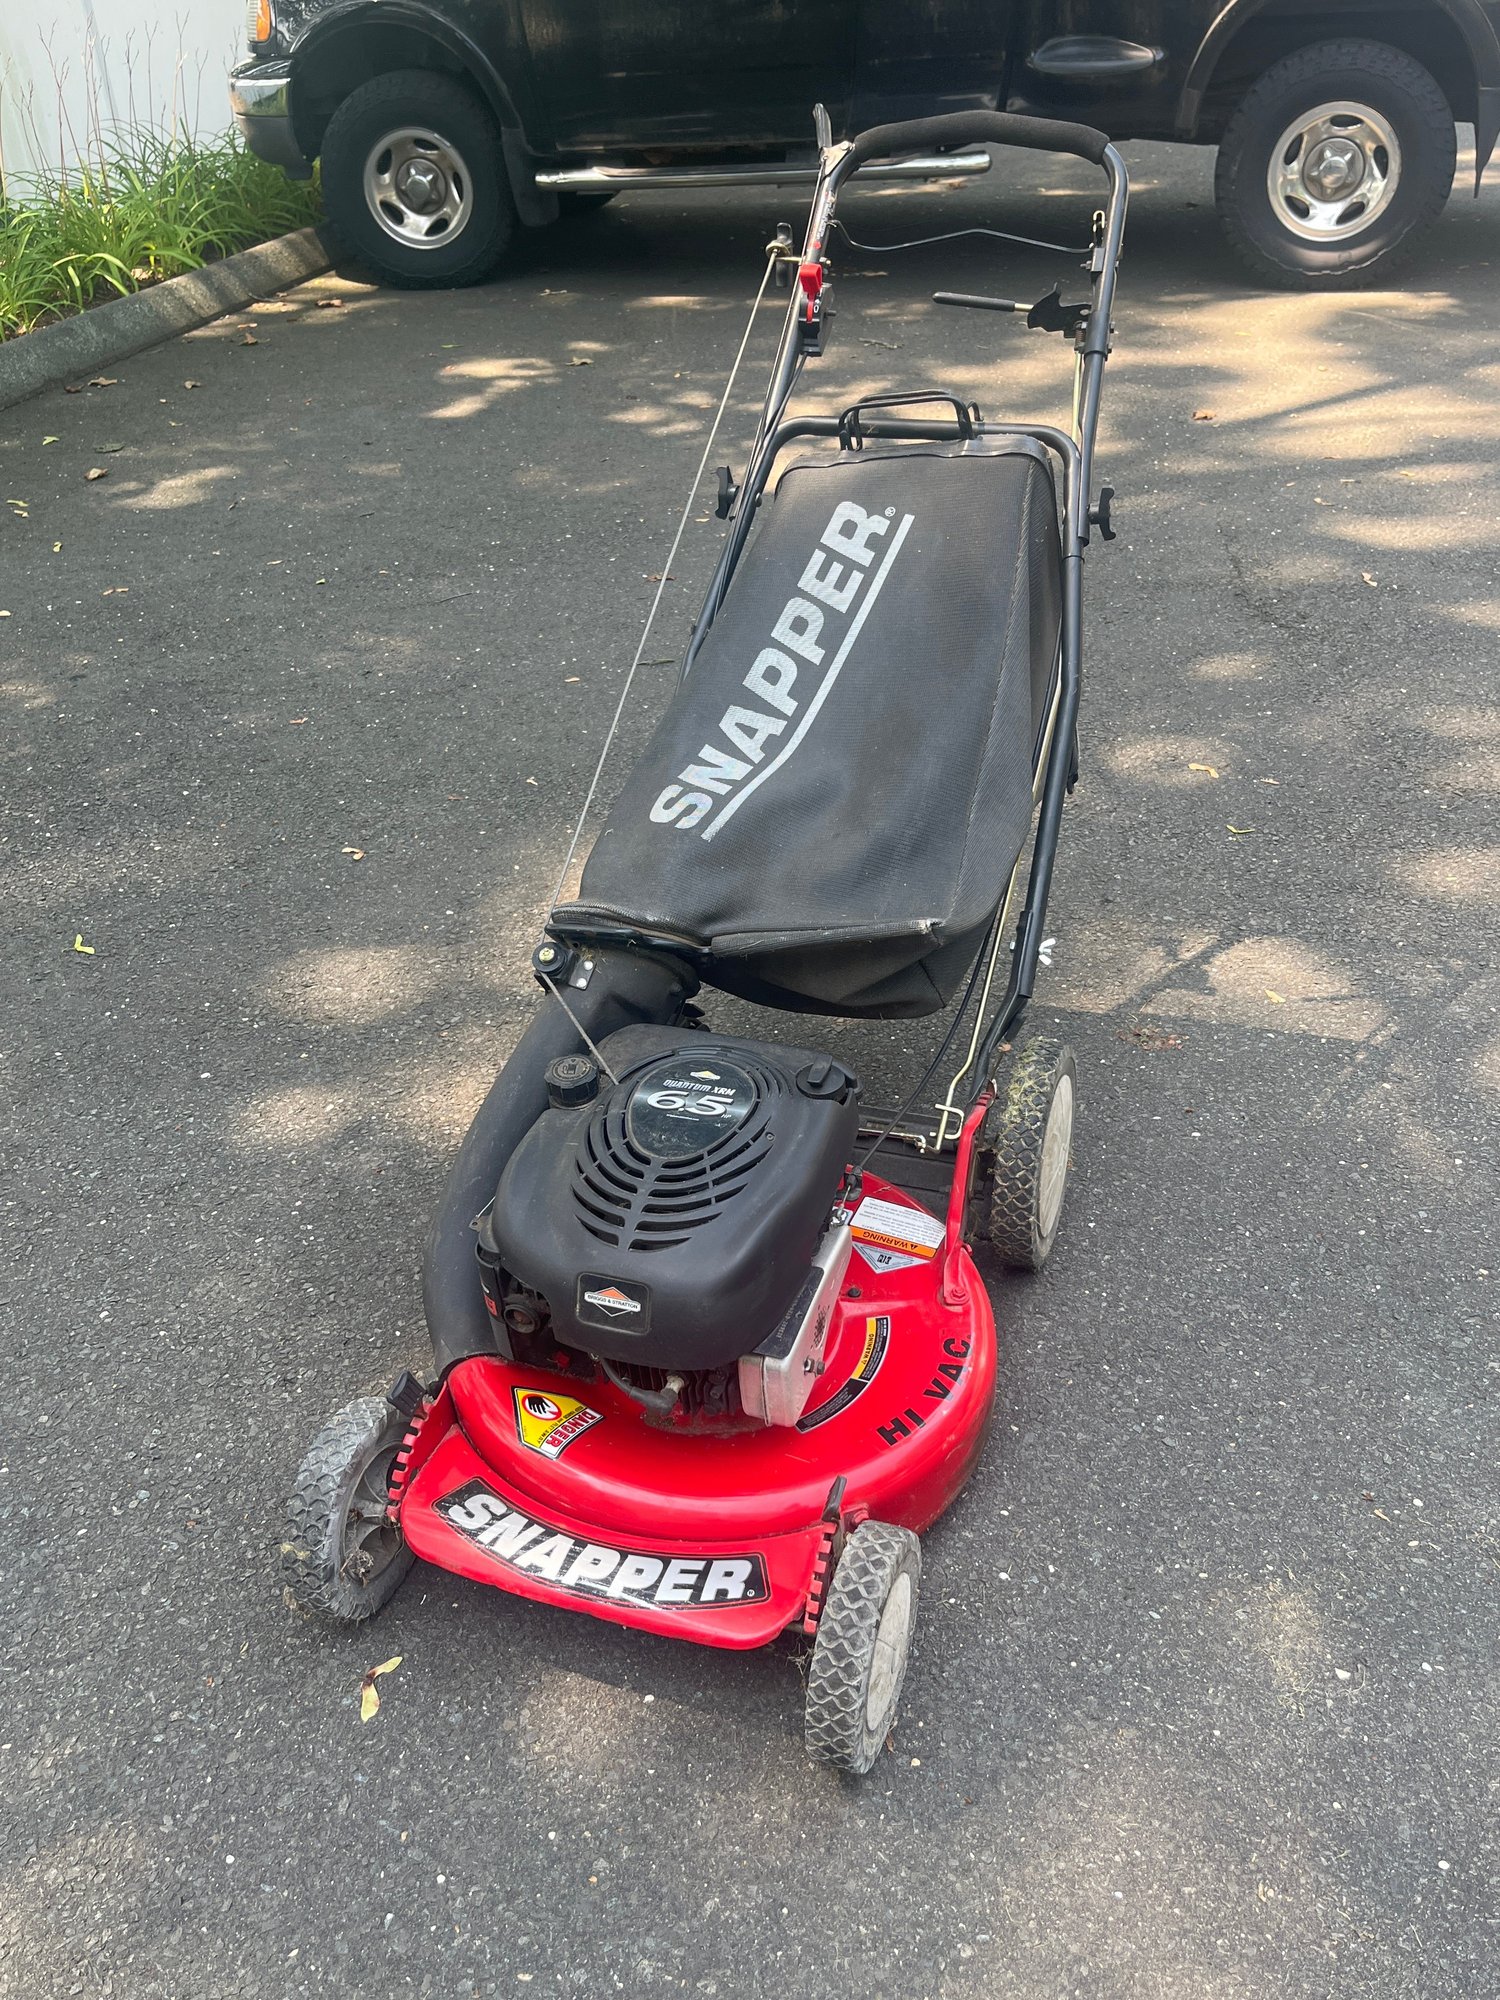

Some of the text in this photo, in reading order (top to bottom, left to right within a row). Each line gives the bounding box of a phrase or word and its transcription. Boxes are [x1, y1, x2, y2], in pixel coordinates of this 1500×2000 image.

[649, 501, 891, 829] SNAPPER
[662, 1079, 737, 1096] QUANTUM XRM
[647, 1090, 734, 1116] 6.5
[862, 1231, 911, 1250] WARNING
[587, 1294, 607, 1303] BRIGGS
[612, 1300, 638, 1310] STRATTON
[862, 1333, 875, 1361] WARNING
[876, 1338, 972, 1446] HI VAC
[545, 1410, 597, 1448] DANGER
[448, 1494, 753, 1602] SNAPPER
